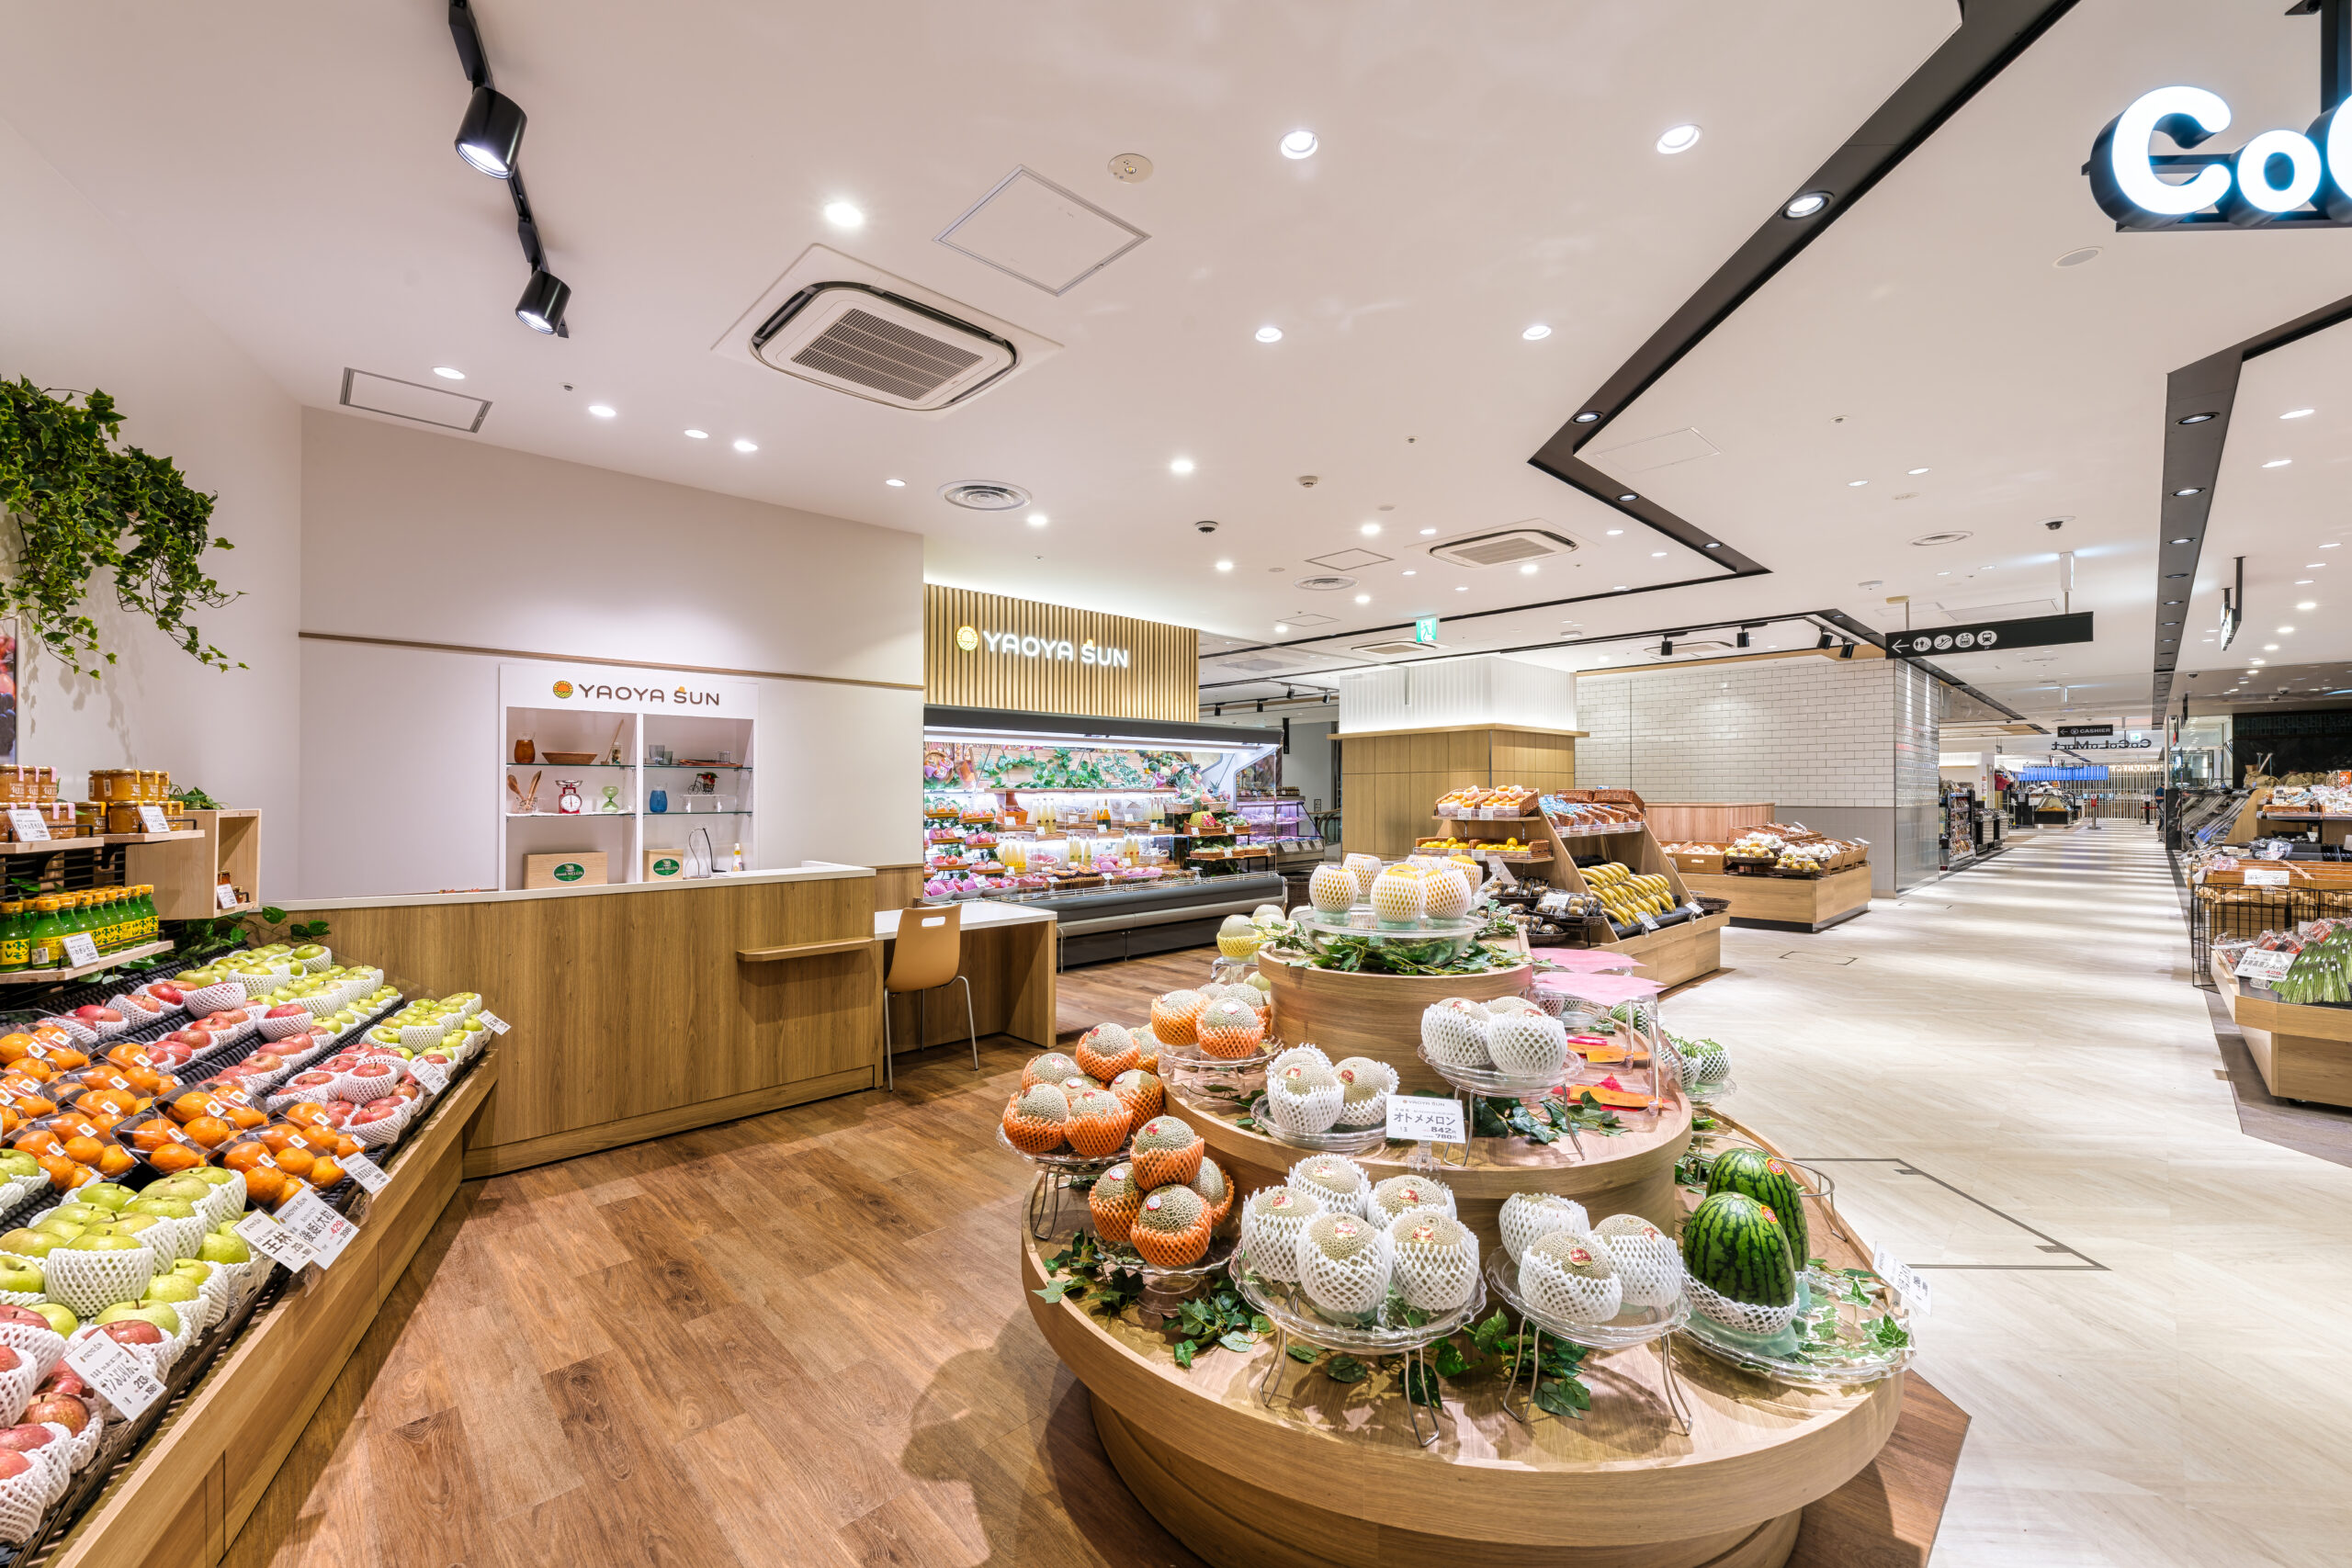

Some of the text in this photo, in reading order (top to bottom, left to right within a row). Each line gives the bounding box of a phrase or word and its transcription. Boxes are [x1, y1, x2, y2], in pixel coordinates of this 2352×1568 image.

[983, 630, 1128, 668] YAOYA SUN
[578, 683, 719, 705] YAOYA SUN
[1394, 1112, 1455, 1125] オトメメロン
[281, 1195, 308, 1220] YAOYA SUN
[299, 1206, 336, 1243] 後姫(大粒)
[260, 1229, 294, 1255] 王林
